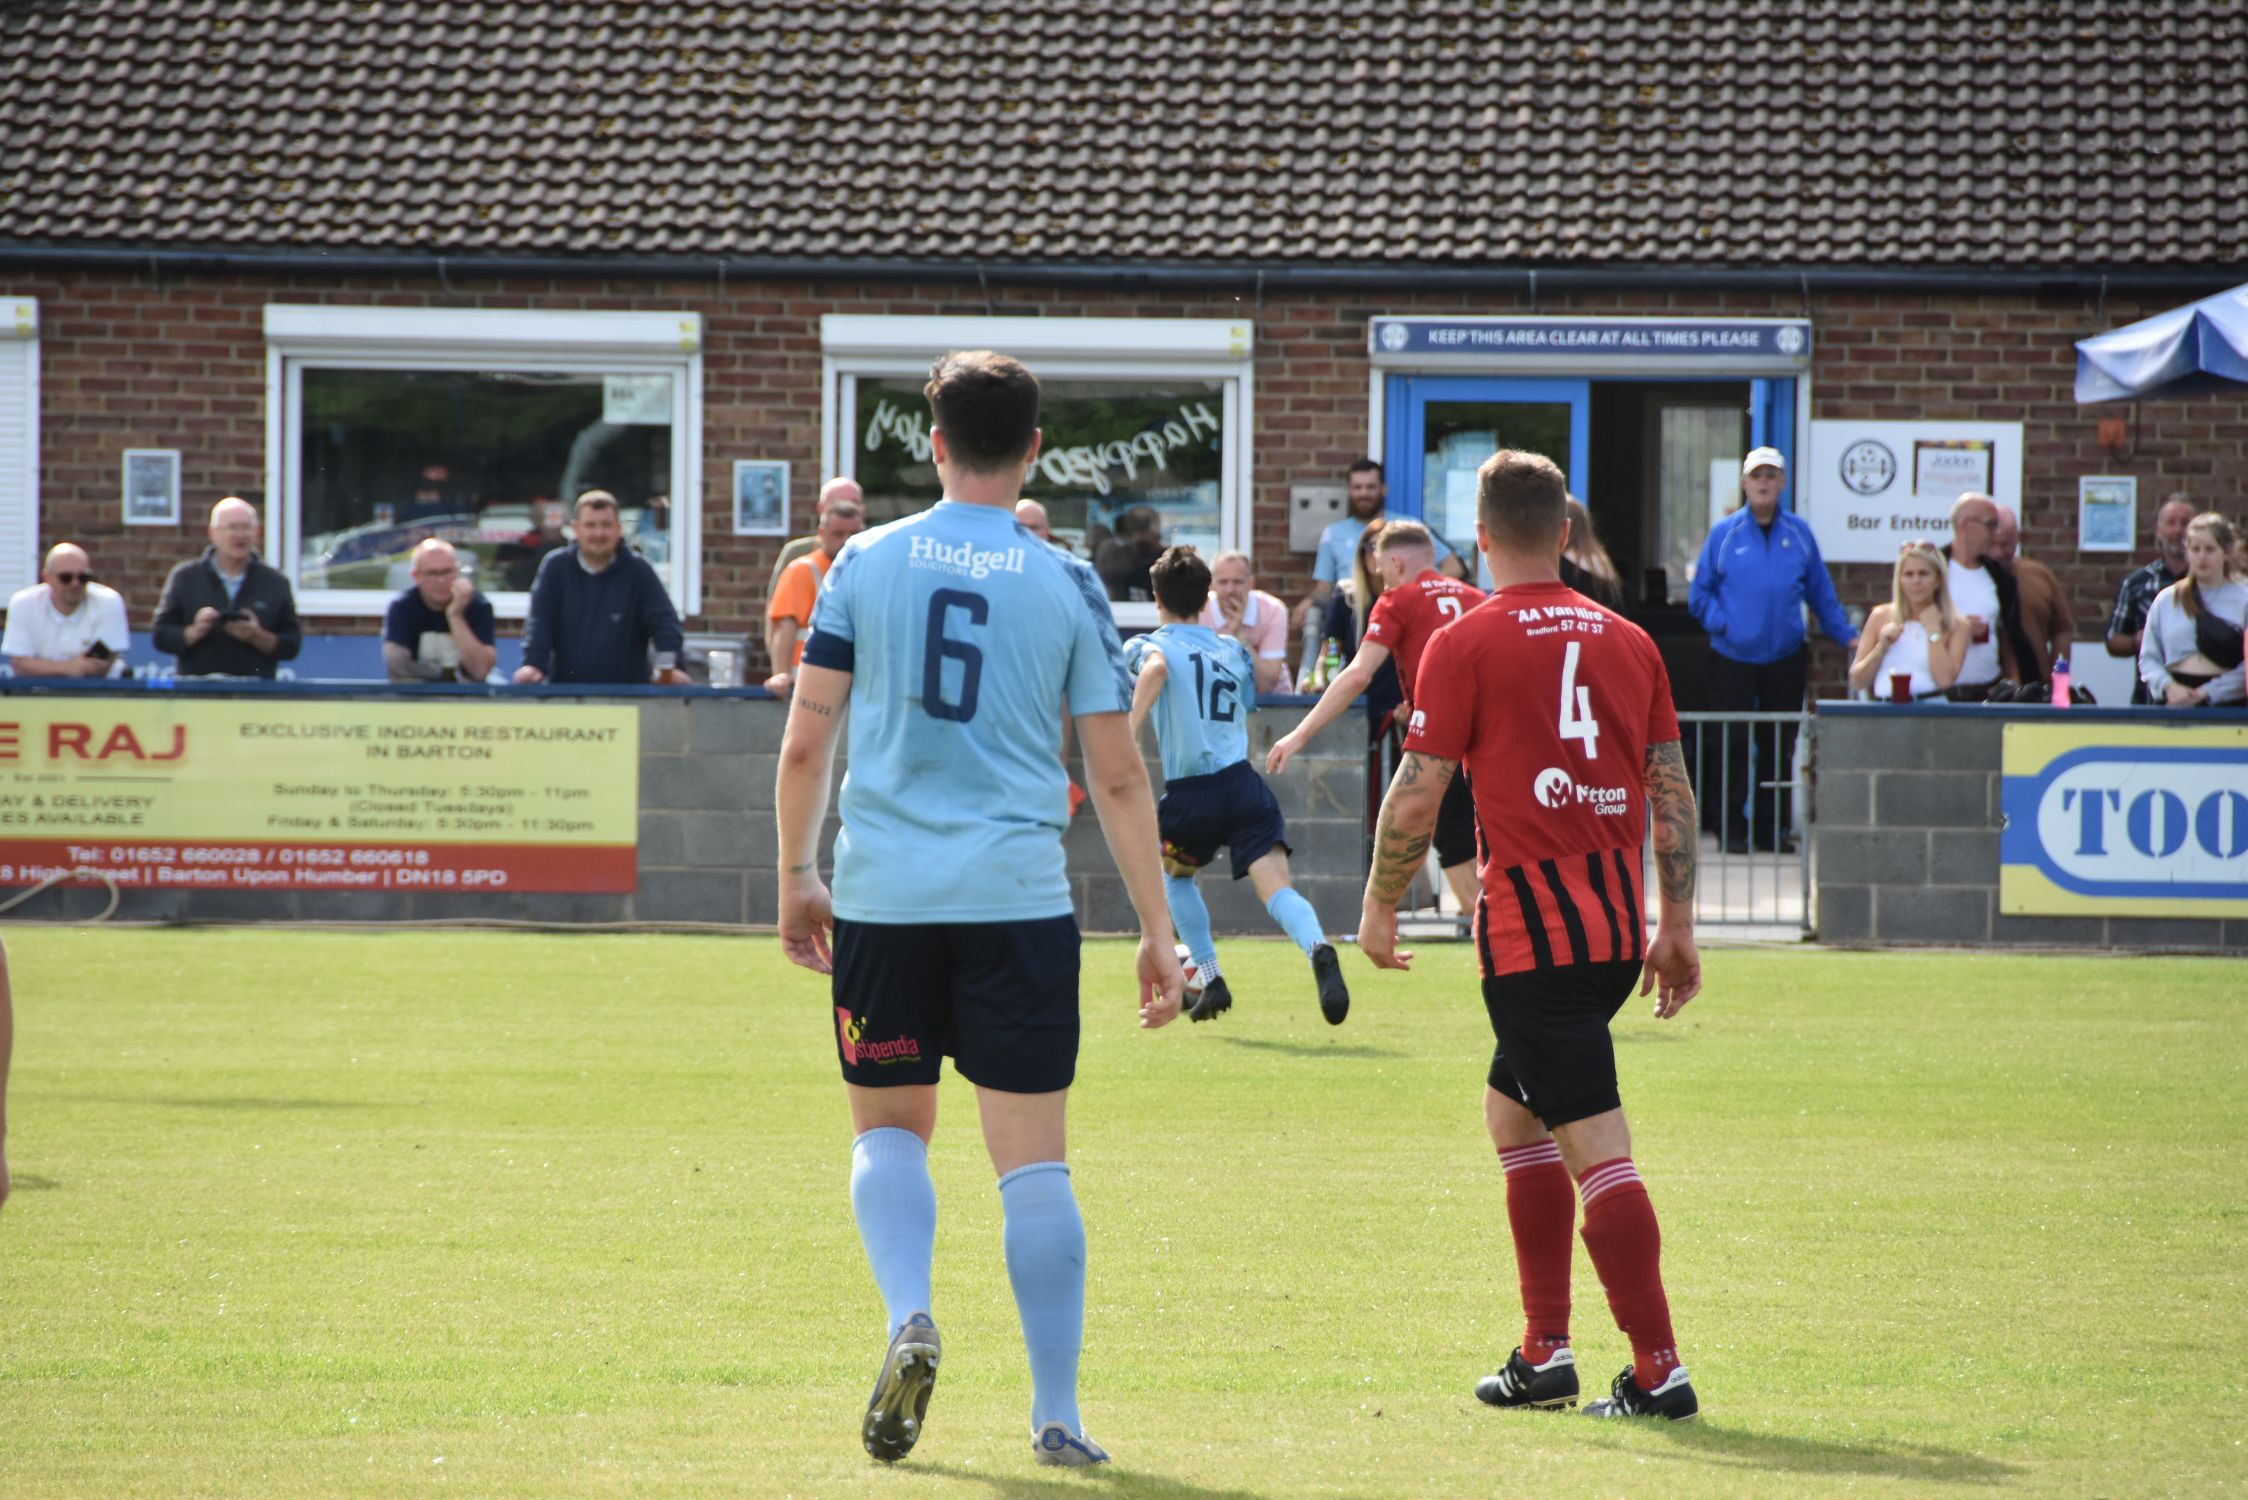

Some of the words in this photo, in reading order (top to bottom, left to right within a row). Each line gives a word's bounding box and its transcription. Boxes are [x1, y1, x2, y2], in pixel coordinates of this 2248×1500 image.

[1428, 329, 1468, 345] KEEP
[1468, 330, 1504, 345] THIS
[1505, 330, 1547, 345] AREA
[1549, 330, 1599, 346] CLEAR
[1600, 331, 1620, 345] AT
[1621, 331, 1650, 346] ALL
[1652, 331, 1699, 346] TIMES
[1701, 331, 1760, 347] PLEASE
[1848, 514, 1882, 530] Bar
[908, 535, 1025, 579] Hudgell
[1518, 608, 1541, 622] AA
[1542, 606, 1574, 618] Van
[1527, 625, 1558, 636] Bradford
[1560, 620, 1574, 631] 57
[1576, 621, 1589, 633] 47
[1590, 623, 1604, 634] 37
[923, 587, 989, 724] 6
[1188, 651, 1236, 723] 12
[1560, 641, 1599, 759] 4
[239, 723, 369, 738] EXCLUSIVE
[378, 725, 456, 739] INDIAN
[463, 726, 618, 741] RESTAURANT
[48, 723, 186, 760] RAJ
[367, 745, 389, 758] IN
[396, 746, 491, 760] BARTON
[273, 783, 338, 798] Sunday
[51, 796, 154, 809] DELIVERY
[1594, 803, 1626, 816] Group
[35, 813, 144, 826] AVAILABLE
[267, 815, 321, 830] Friday
[110, 847, 177, 863] 01652
[279, 848, 346, 865] 01652
[157, 866, 228, 883] Barton
[233, 867, 290, 886] Upon
[294, 868, 378, 885] Humber
[396, 869, 456, 886] DN18
[461, 870, 508, 886] 5PD
